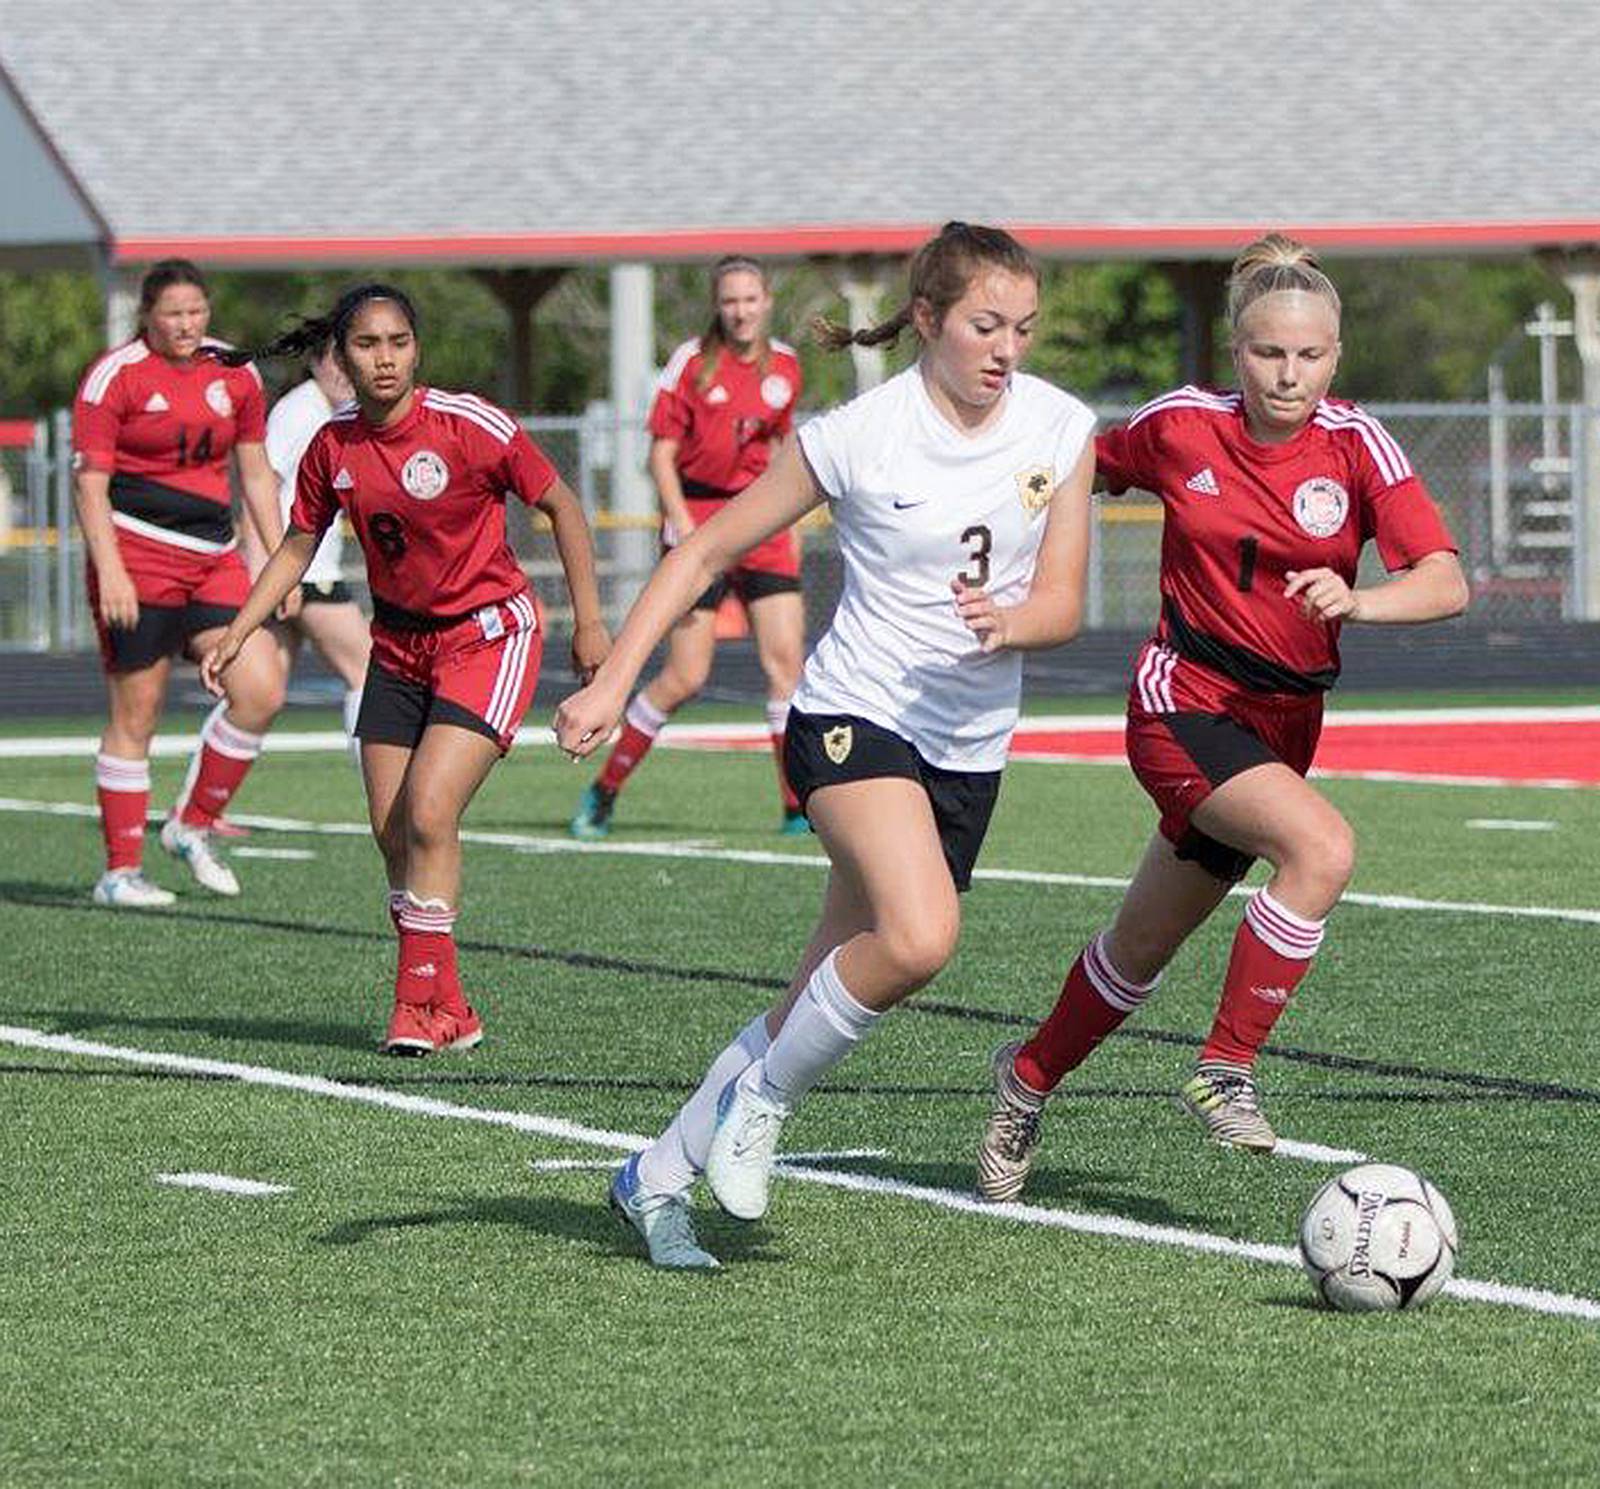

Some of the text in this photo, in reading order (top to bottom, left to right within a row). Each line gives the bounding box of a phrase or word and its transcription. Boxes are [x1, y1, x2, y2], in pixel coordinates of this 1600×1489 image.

[175, 423, 216, 469] 14
[957, 524, 993, 588] 3
[1238, 535, 1258, 593] 1
[1350, 1191, 1384, 1278] SPALDING
